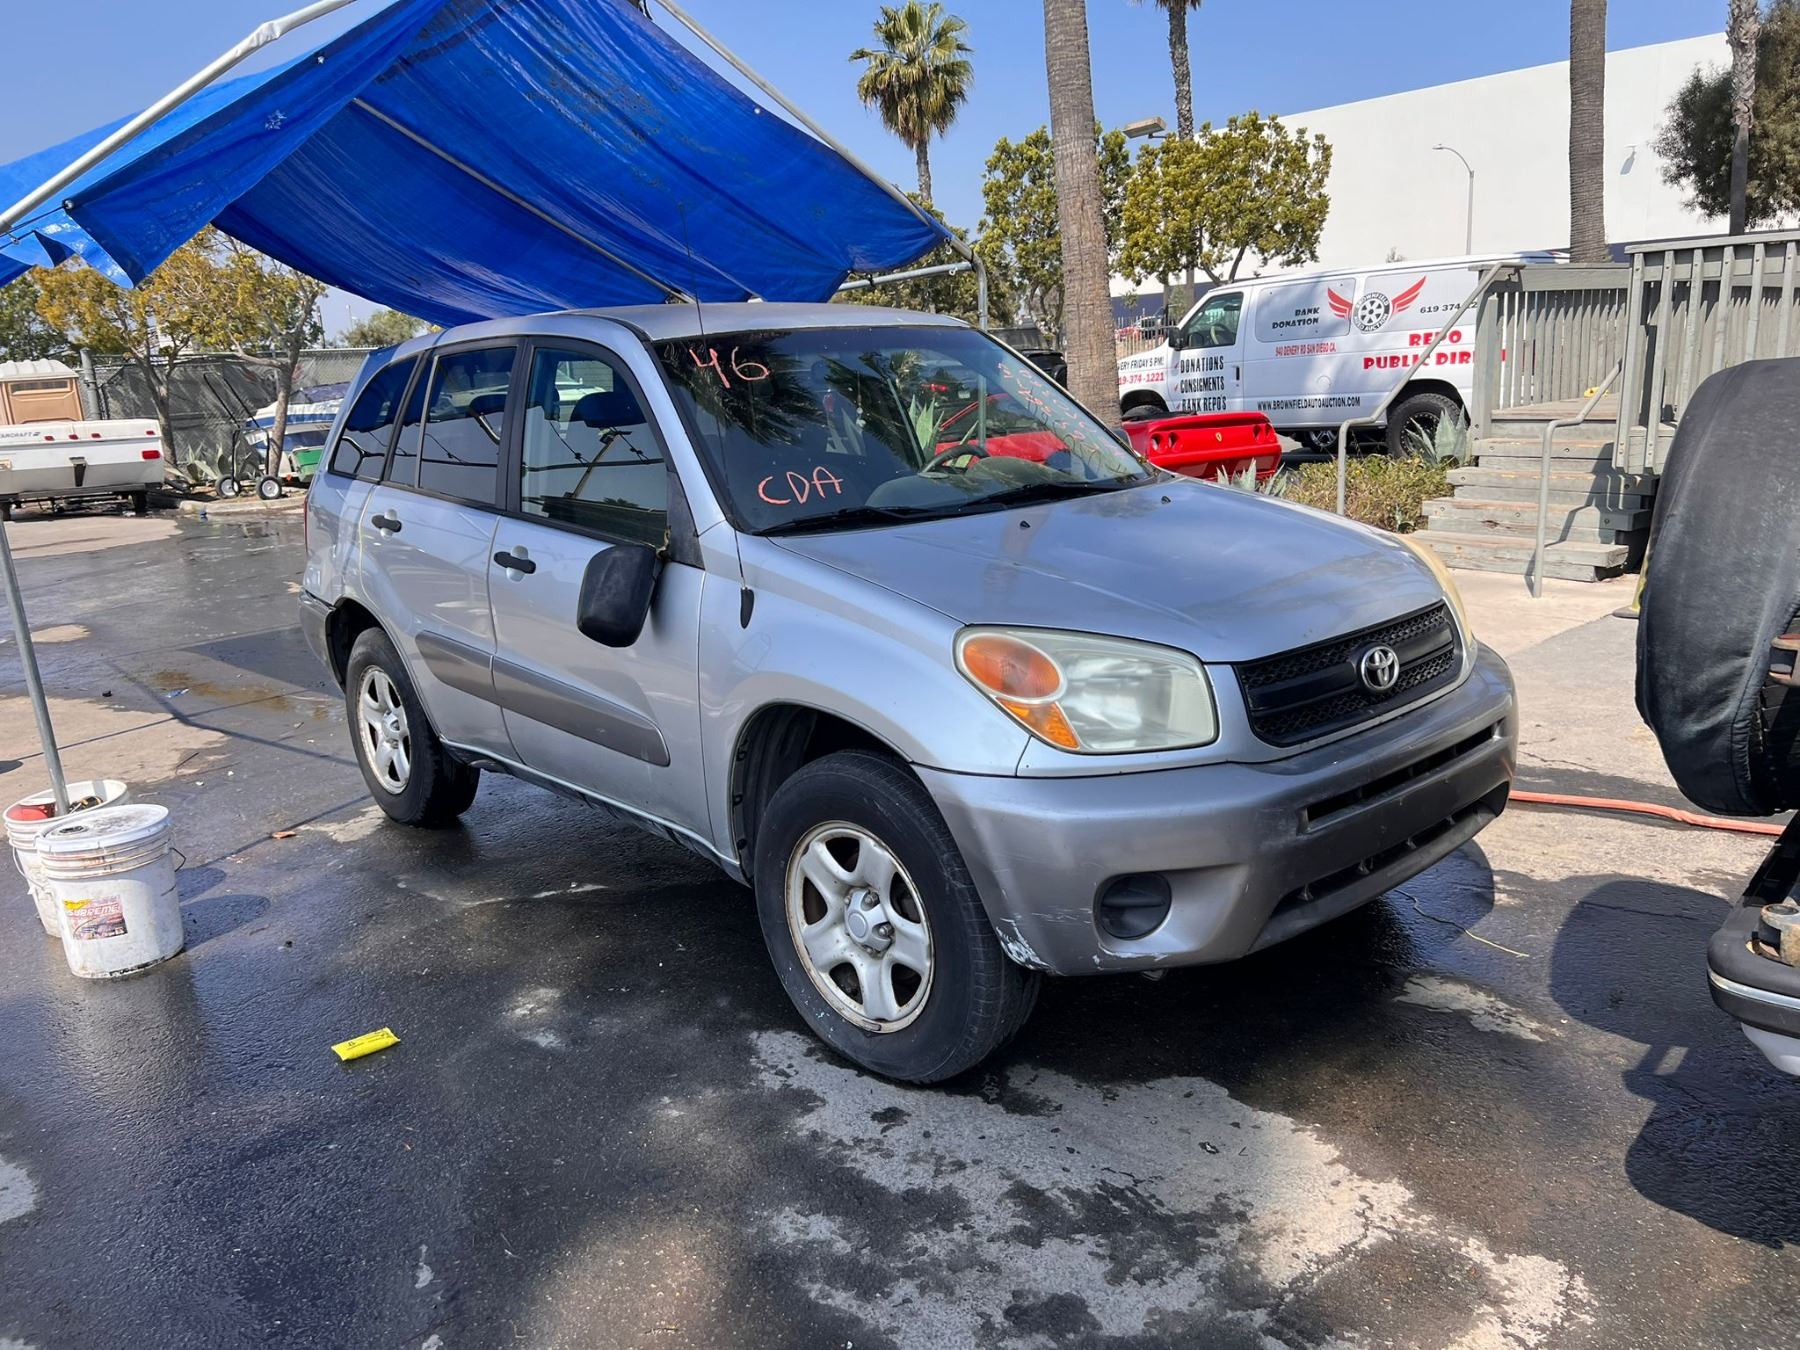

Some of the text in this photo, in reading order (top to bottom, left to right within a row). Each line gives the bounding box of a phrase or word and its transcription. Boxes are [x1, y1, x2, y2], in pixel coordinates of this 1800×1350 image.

[1355, 292, 1389, 308] BROWNFIELD
[1295, 307, 1320, 316] BANK
[1420, 305, 1439, 314] 619
[1272, 317, 1319, 329] DONATION
[1363, 313, 1388, 331] AUCTION
[1307, 344, 1315, 354] SAN
[1316, 342, 1328, 353] DIEGO
[689, 346, 770, 389] 46
[1117, 361, 1130, 371] ERY
[1131, 358, 1149, 369] FRIDAY
[1149, 358, 1153, 367] 5
[1180, 356, 1224, 374] DONATIONS
[1363, 353, 1430, 370] PUBLI
[1117, 372, 1165, 386] 19-374-1221
[1180, 376, 1225, 393] CONSIGMENTS
[1182, 395, 1226, 412] BANK REPO'S
[1257, 396, 1360, 410] WWW.BROWNFIELDAUTOAUCTION.COM
[758, 466, 844, 505] CDA
